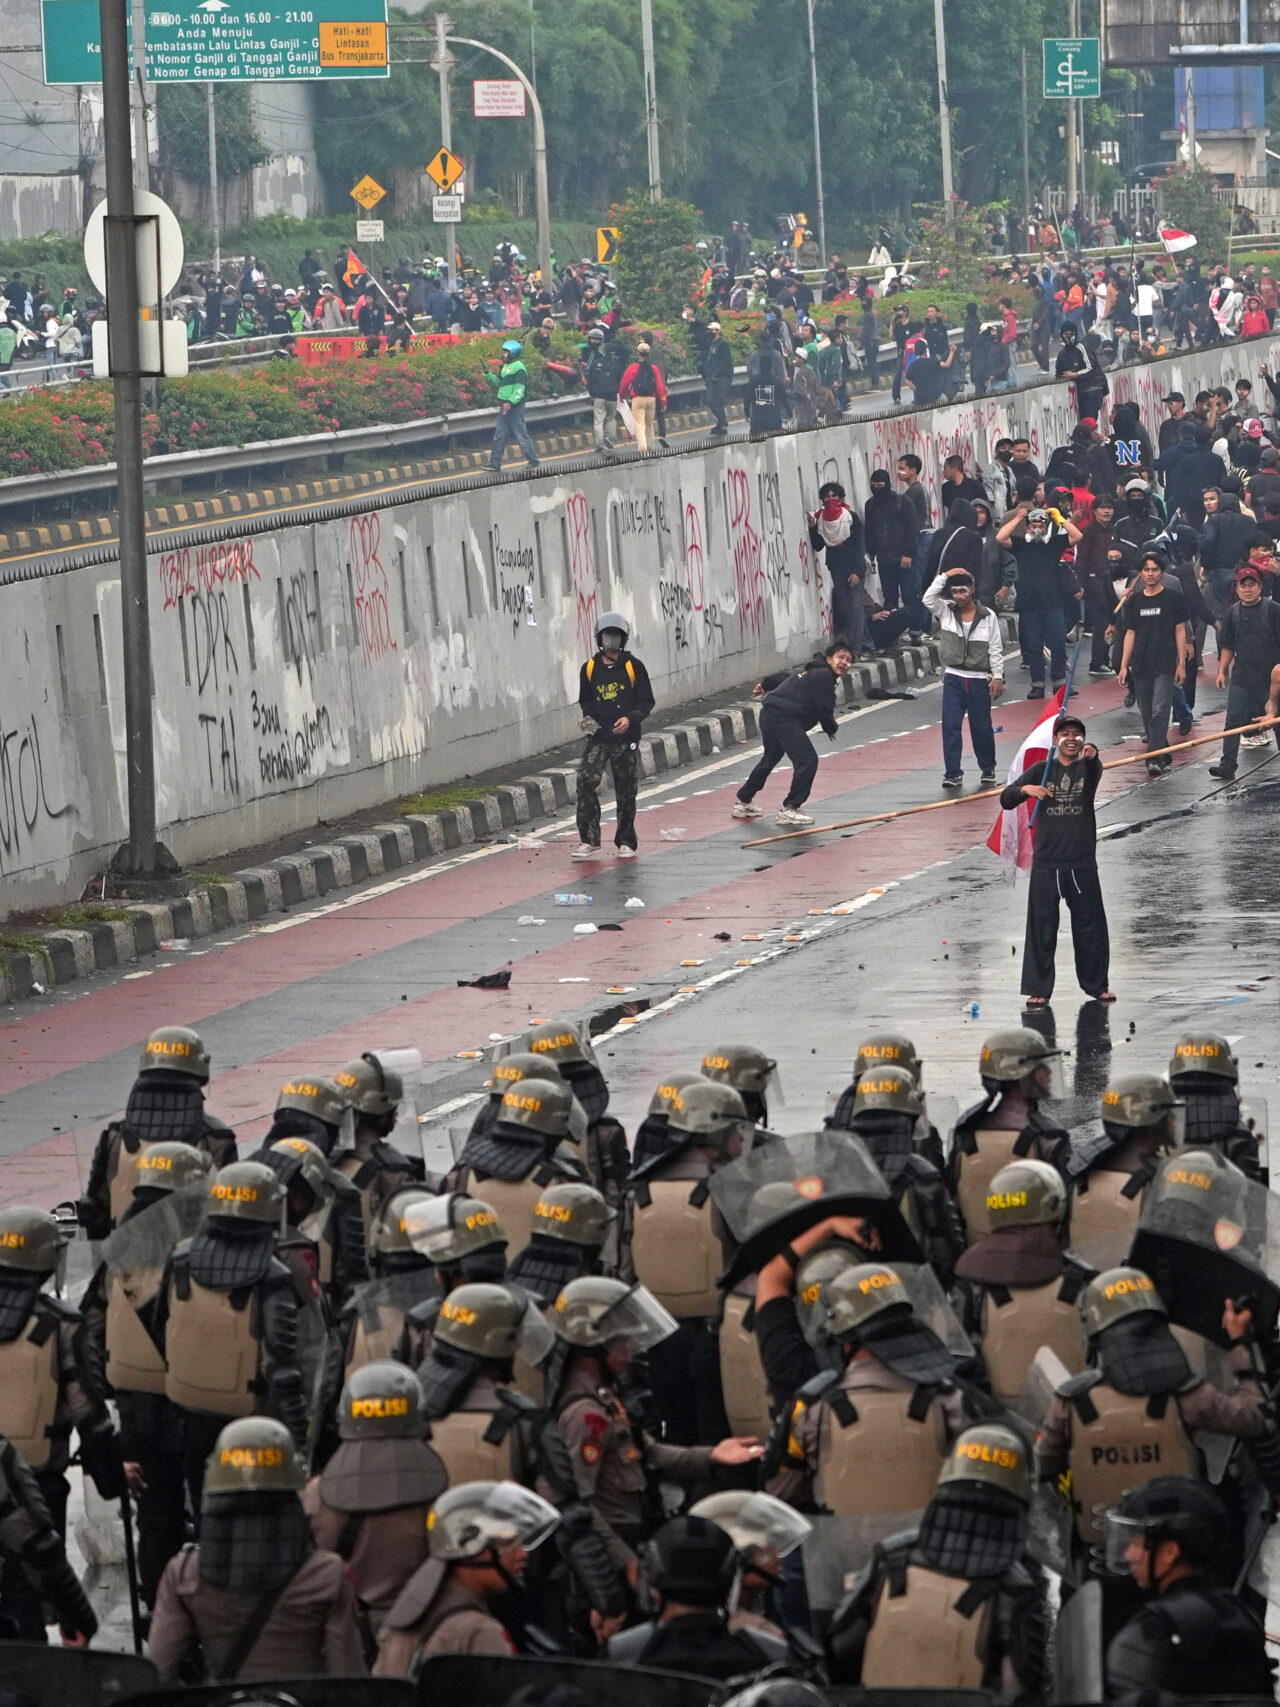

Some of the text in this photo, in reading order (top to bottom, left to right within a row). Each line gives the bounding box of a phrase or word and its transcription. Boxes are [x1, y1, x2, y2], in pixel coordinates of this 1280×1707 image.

[190, 14, 215, 25] 10.00
[220, 13, 239, 24] dan
[245, 12, 271, 23] 16.00
[285, 11, 313, 23] 21.00
[177, 27, 253, 39] Anda Menuju
[208, 40, 231, 50] Lalu
[234, 39, 266, 50] Lintas
[270, 38, 300, 51] Ganjil
[336, 39, 370, 49] Lintasan
[157, 54, 191, 65] Nomor
[194, 53, 223, 66] Ganjil
[227, 53, 237, 63] di
[240, 52, 282, 64] Tanggal
[287, 51, 318, 63] Ganjil
[322, 51, 385, 63] Bus Transjakarta
[154, 67, 189, 78] Nomor
[193, 66, 227, 78] Genap
[231, 66, 240, 75] di
[243, 65, 285, 77] Tanggal
[288, 64, 322, 76] Genap
[1114, 439, 1142, 467] N
[146, 1041, 190, 1056] POLISI
[1176, 1043, 1218, 1058] POLISI
[351, 1397, 407, 1419] POLISI
[219, 1447, 283, 1468] POLISI
[1091, 1442, 1161, 1467] POLISI
